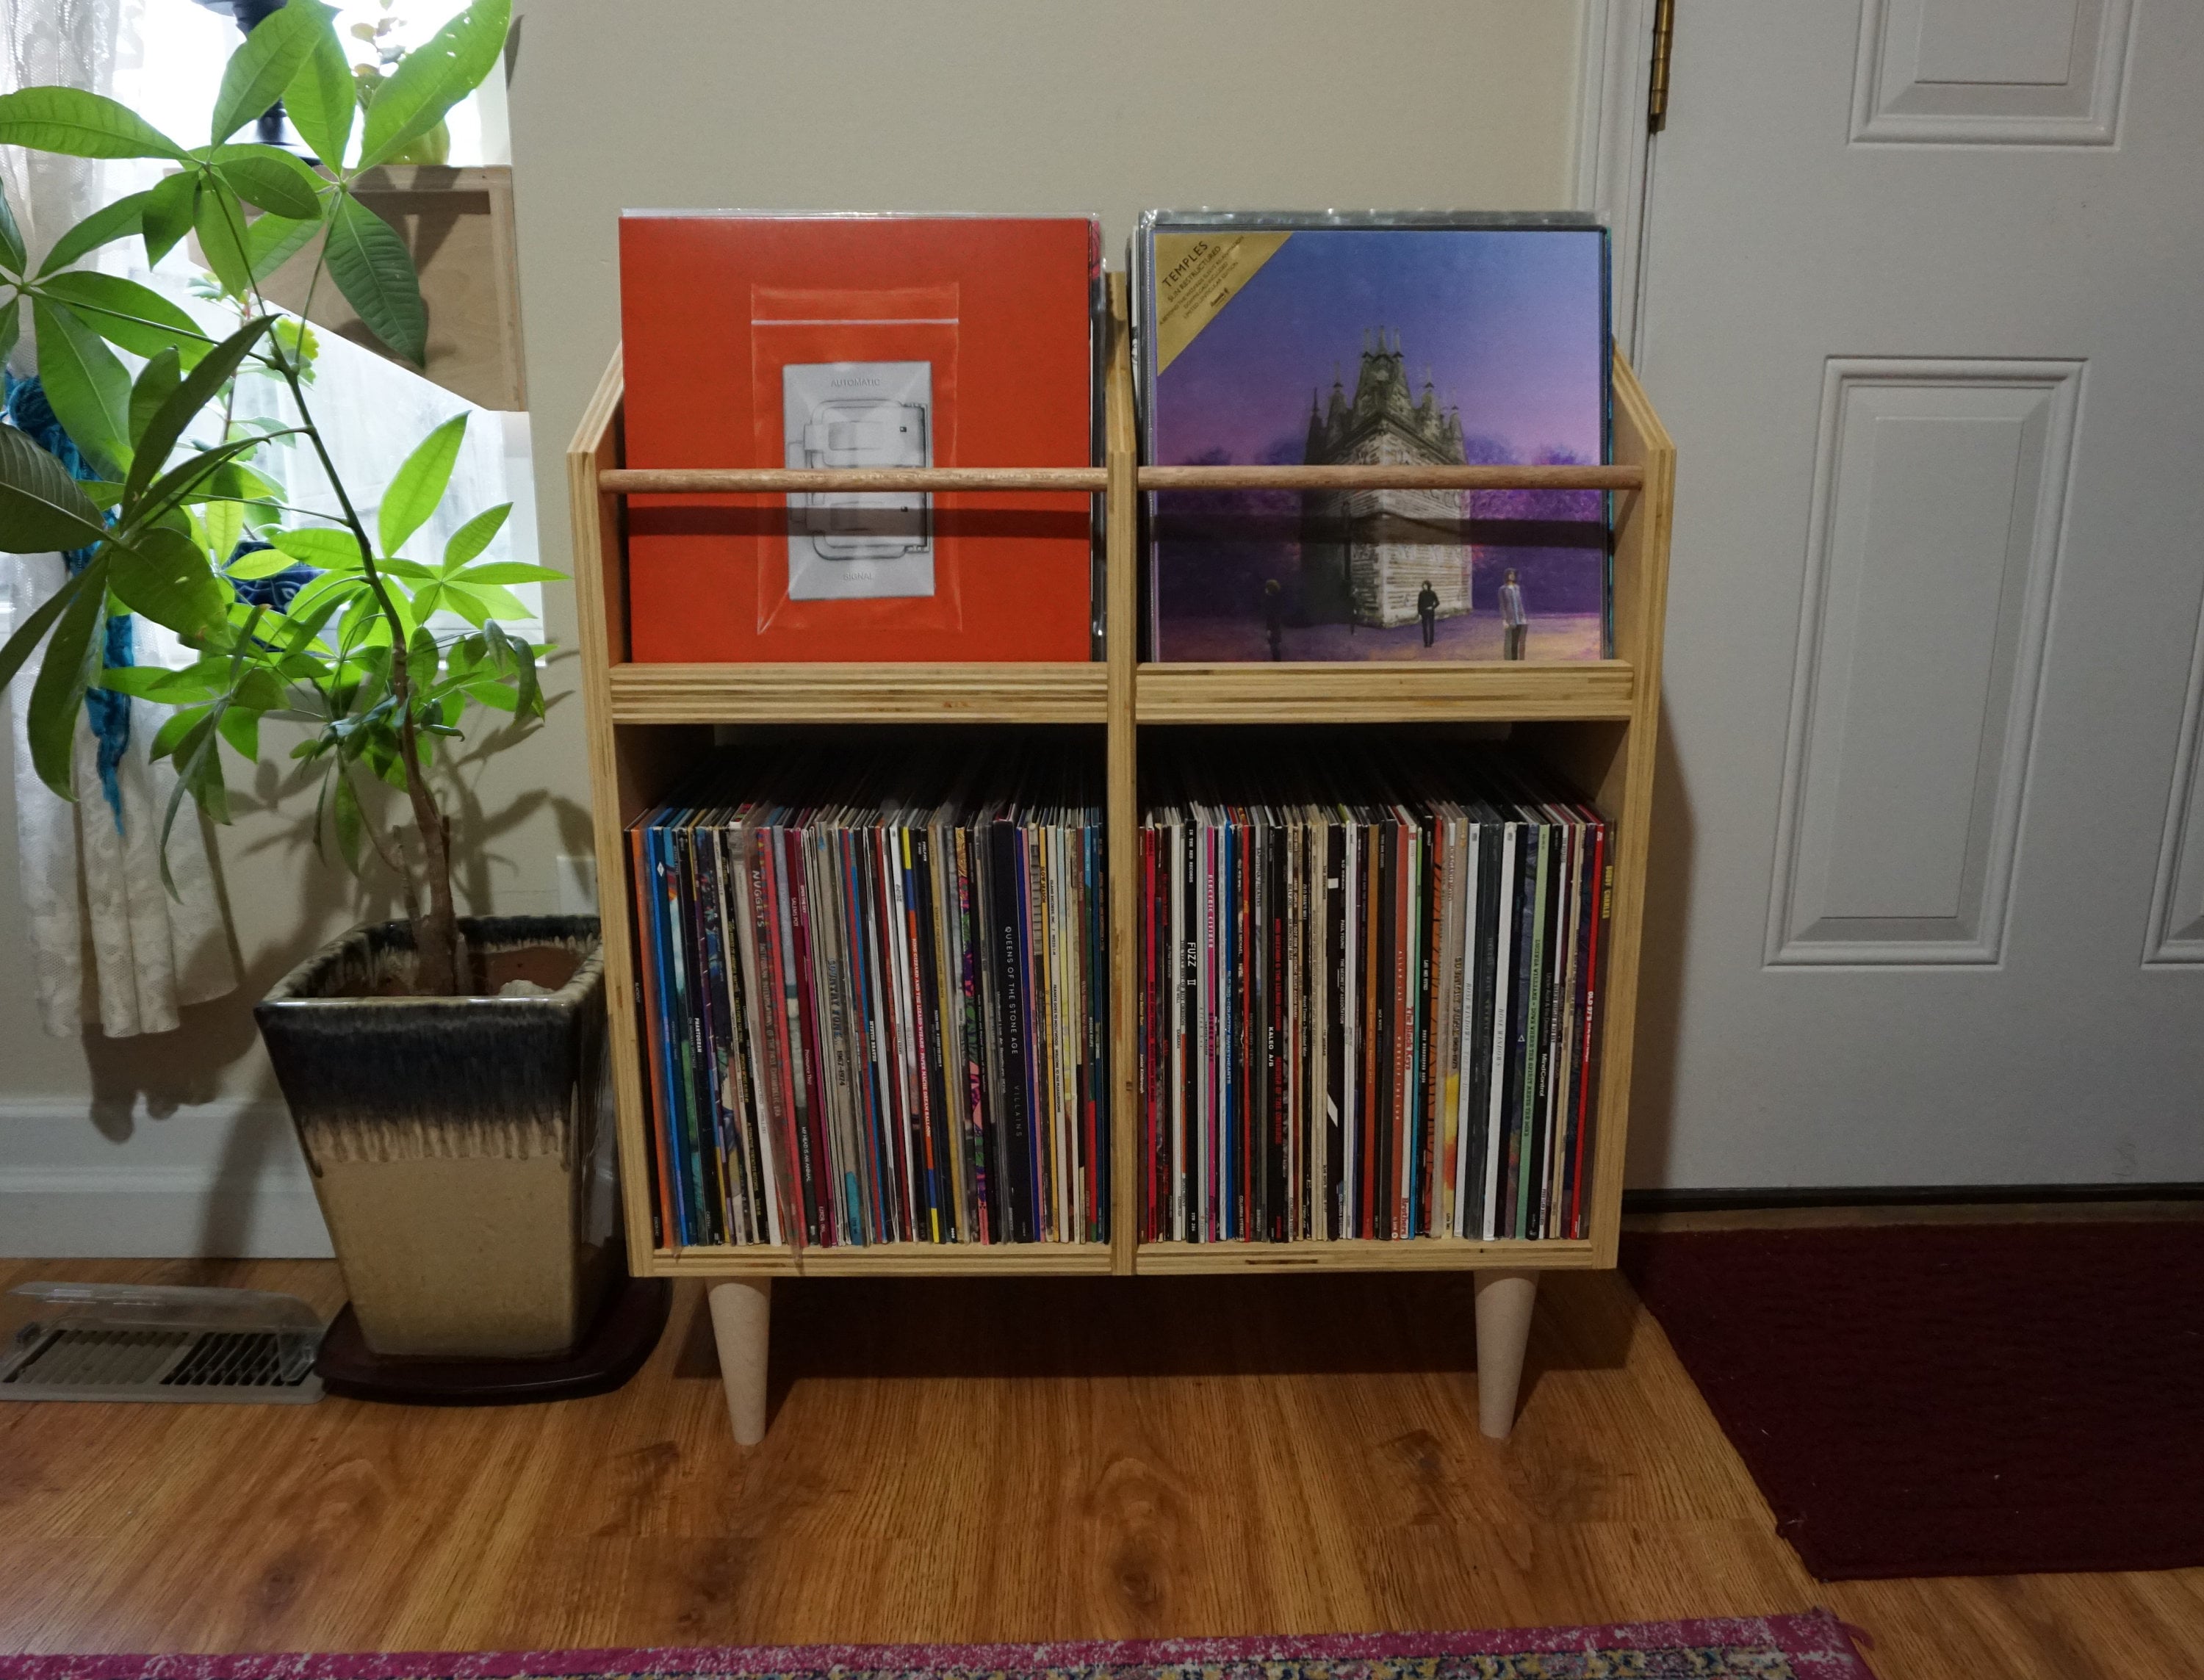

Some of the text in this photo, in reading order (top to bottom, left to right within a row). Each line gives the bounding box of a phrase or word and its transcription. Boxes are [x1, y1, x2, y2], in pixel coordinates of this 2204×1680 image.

[1162, 241, 1209, 287] TEMPLES
[1167, 246, 1221, 302] SUN RESTRUCTURED
[831, 378, 880, 388] AUTOMATIC
[843, 572, 873, 581] SIGNAL
[752, 870, 765, 927] NUGGETS
[1602, 865, 1613, 919] BOBBY CHARLES
[1005, 926, 1013, 962] QUEENS
[1187, 942, 1196, 967] FUZZ
[1007, 967, 1014, 978] OF
[1453, 956, 1462, 1003] COUNTRY
[828, 958, 843, 1039] COUNTRY FUNK
[837, 1050, 846, 1085] 1967-1974
[1405, 1050, 1413, 1070] Keys
[1014, 1085, 1022, 1137] VILLAINS
